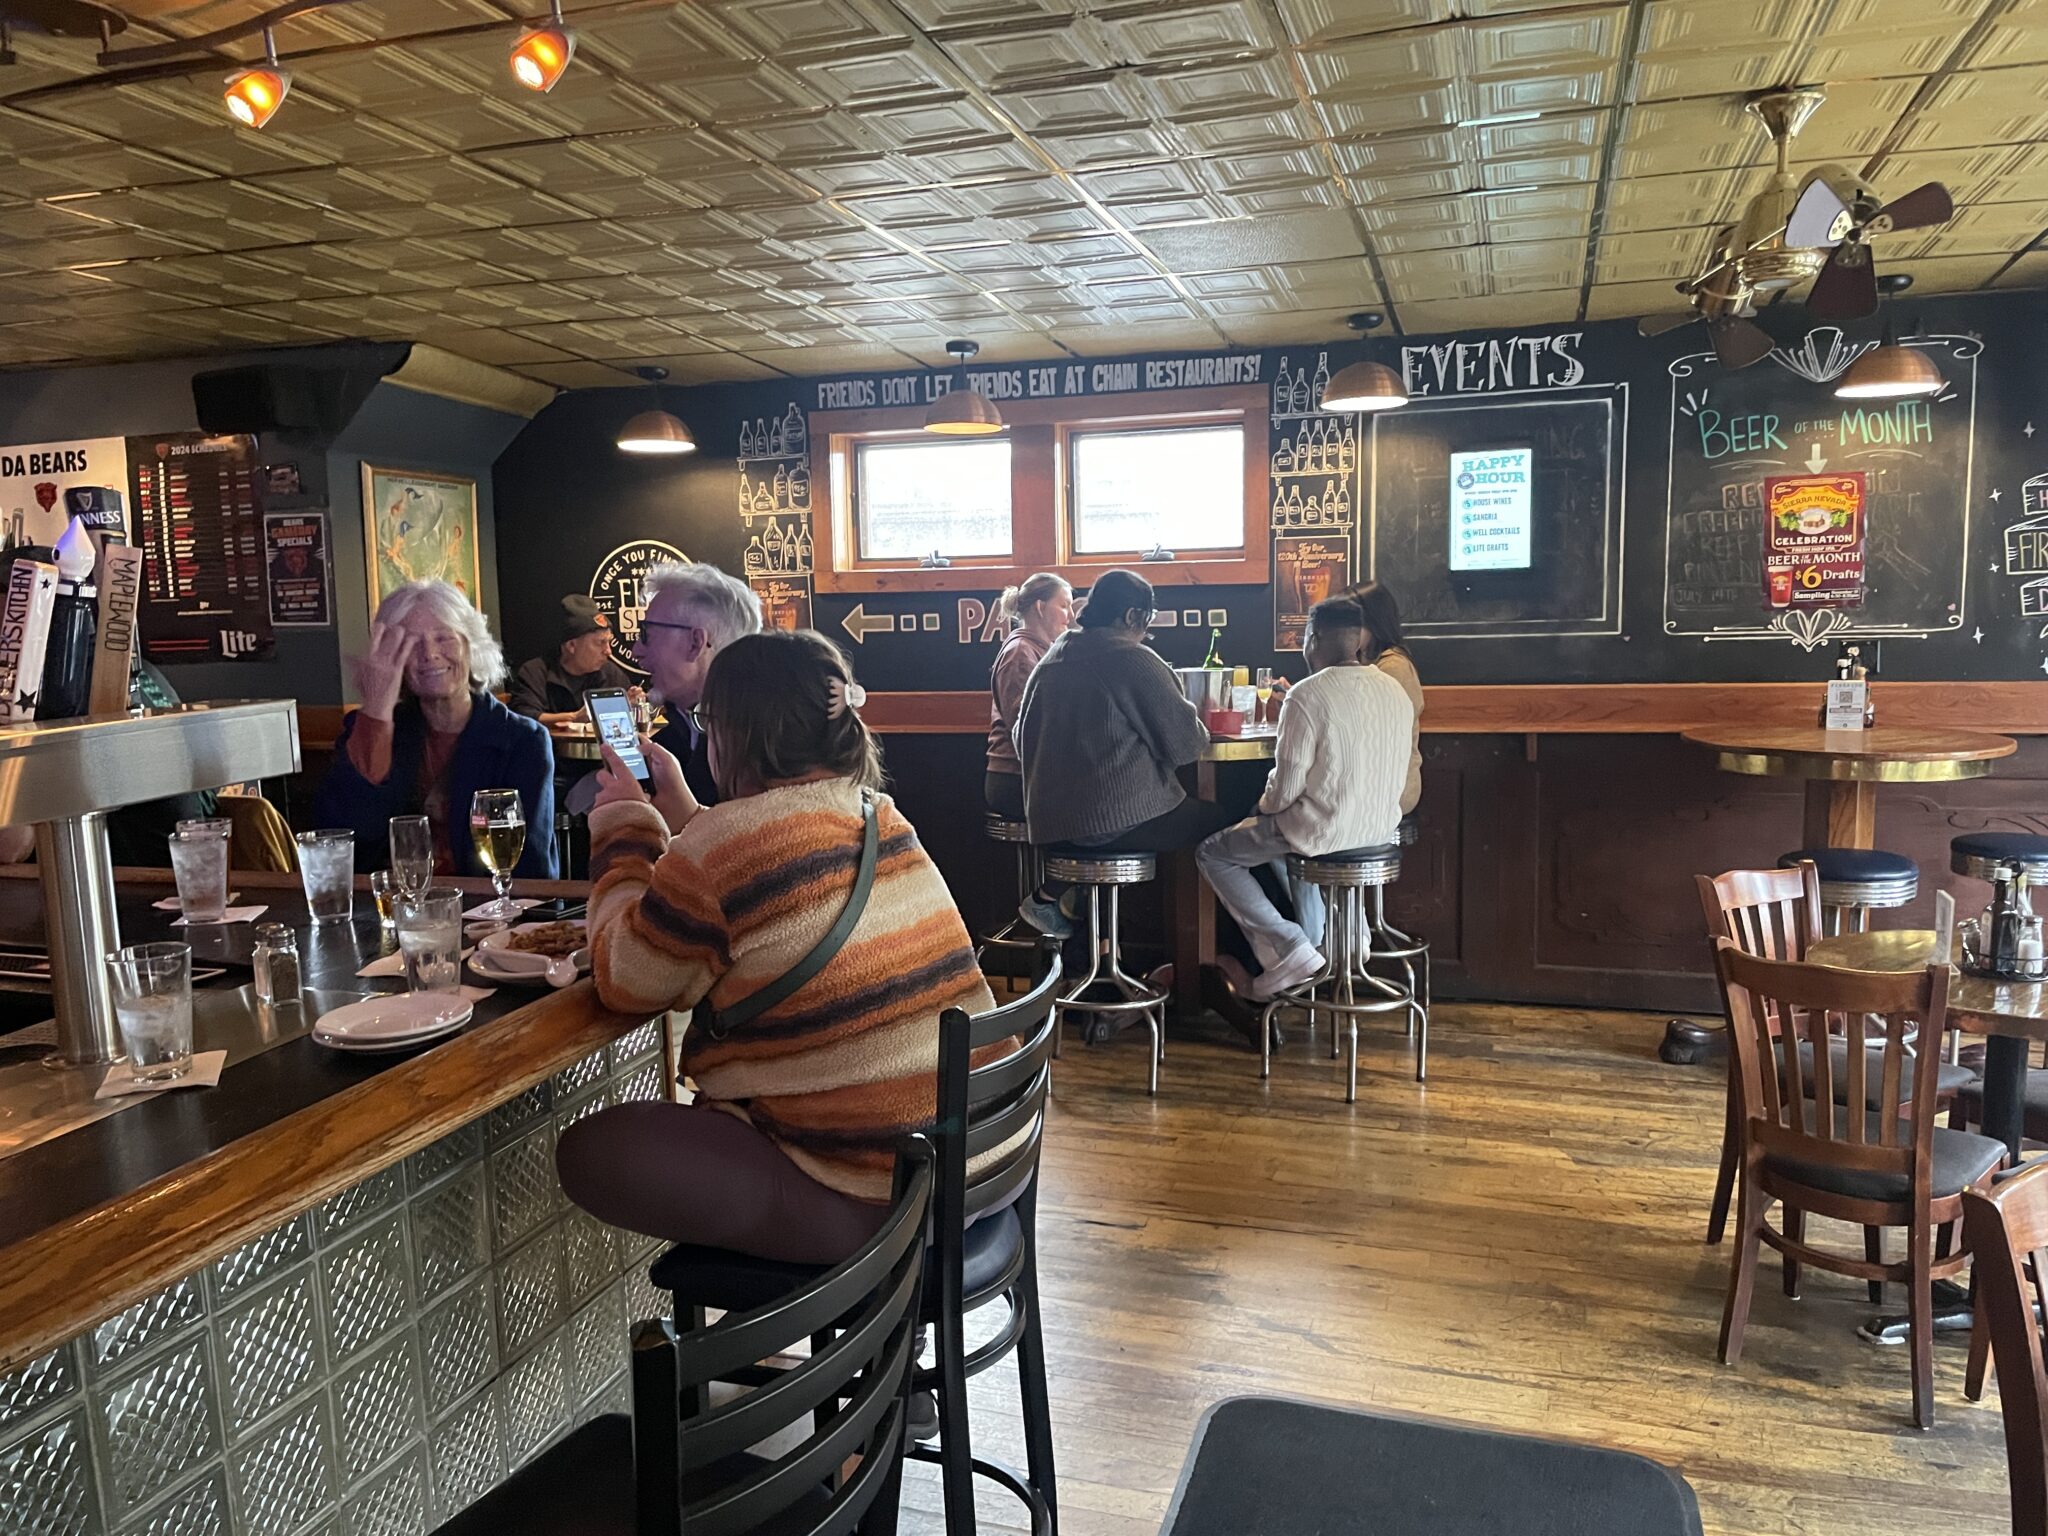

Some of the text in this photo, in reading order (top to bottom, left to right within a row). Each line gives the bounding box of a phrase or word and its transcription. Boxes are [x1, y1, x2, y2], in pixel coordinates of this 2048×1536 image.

[1402, 332, 1585, 396] EVENTS
[818, 380, 876, 409] FRIENDS
[925, 374, 952, 402] LET
[967, 371, 1022, 400] RIENDS
[1029, 367, 1057, 396] EAT
[1064, 366, 1085, 394] AT
[1093, 363, 1138, 392] CHAIN
[1146, 354, 1262, 389] RESTAURANTS!
[1700, 400, 1933, 459] BEER OF THE MONTH
[171, 445, 190, 456] 2024
[2, 450, 87, 477] DA BEARS
[1462, 455, 1525, 472] HAPPY
[1475, 472, 1525, 484] HOUR
[1473, 498, 1491, 506] HOUSE
[1493, 497, 1512, 505] WINES
[1782, 496, 1847, 510] SIERRA NEVADA
[1473, 513, 1498, 521] SANGRIA
[1473, 529, 1488, 537] WELL
[1489, 527, 1520, 536] COCKTAILS
[277, 536, 313, 548] SPECIALS
[1775, 534, 1853, 546] CELEBRATION
[1768, 555, 1800, 566] BEER
[1812, 552, 1860, 564] MONTH
[600, 560, 623, 590] ONCE
[622, 550, 645, 564] YOU
[1795, 565, 1860, 589] $6 Drafts
[1794, 591, 1831, 600] Sampling
[105, 558, 137, 652] MAPLEWOOD
[220, 630, 257, 658] Lite
